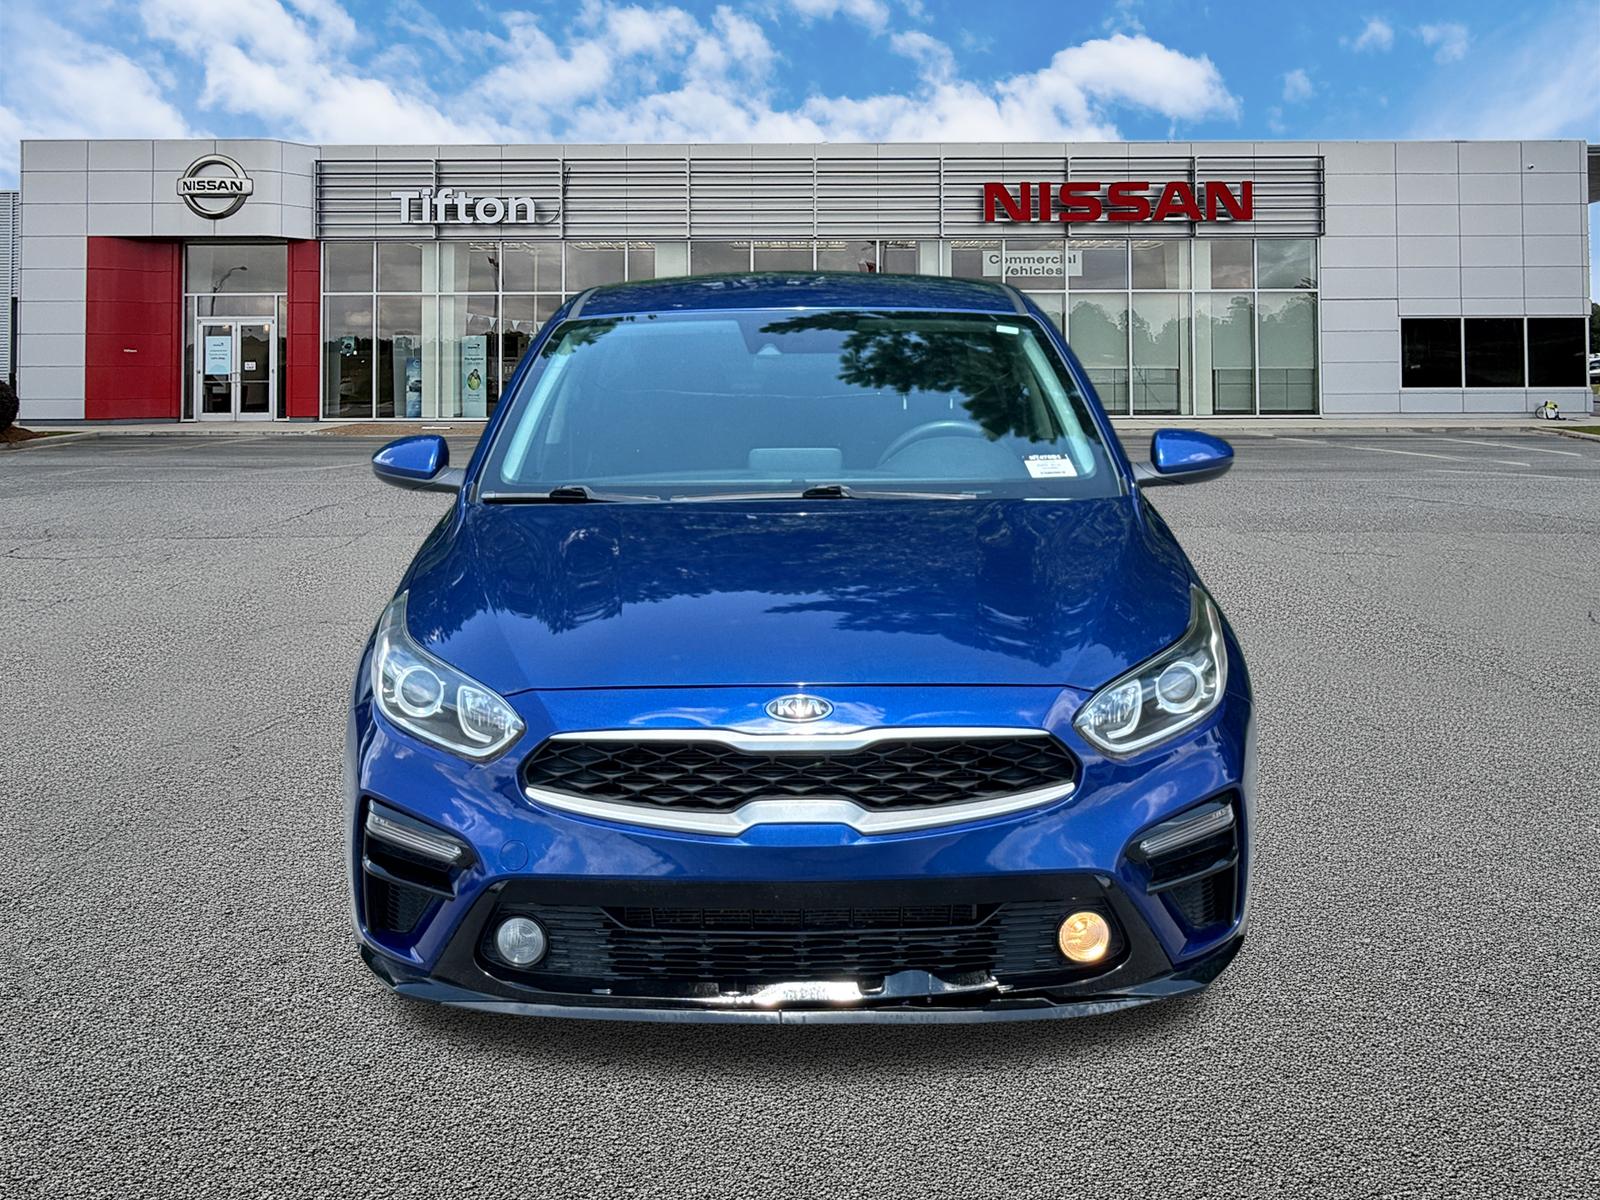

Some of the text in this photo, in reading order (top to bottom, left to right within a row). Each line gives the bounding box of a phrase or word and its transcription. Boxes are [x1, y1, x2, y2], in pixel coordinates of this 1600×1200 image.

[182, 180, 243, 191] NISSAN
[391, 187, 536, 224] Tifton
[983, 181, 1253, 222] NISSAN
[776, 698, 823, 717] KIA
